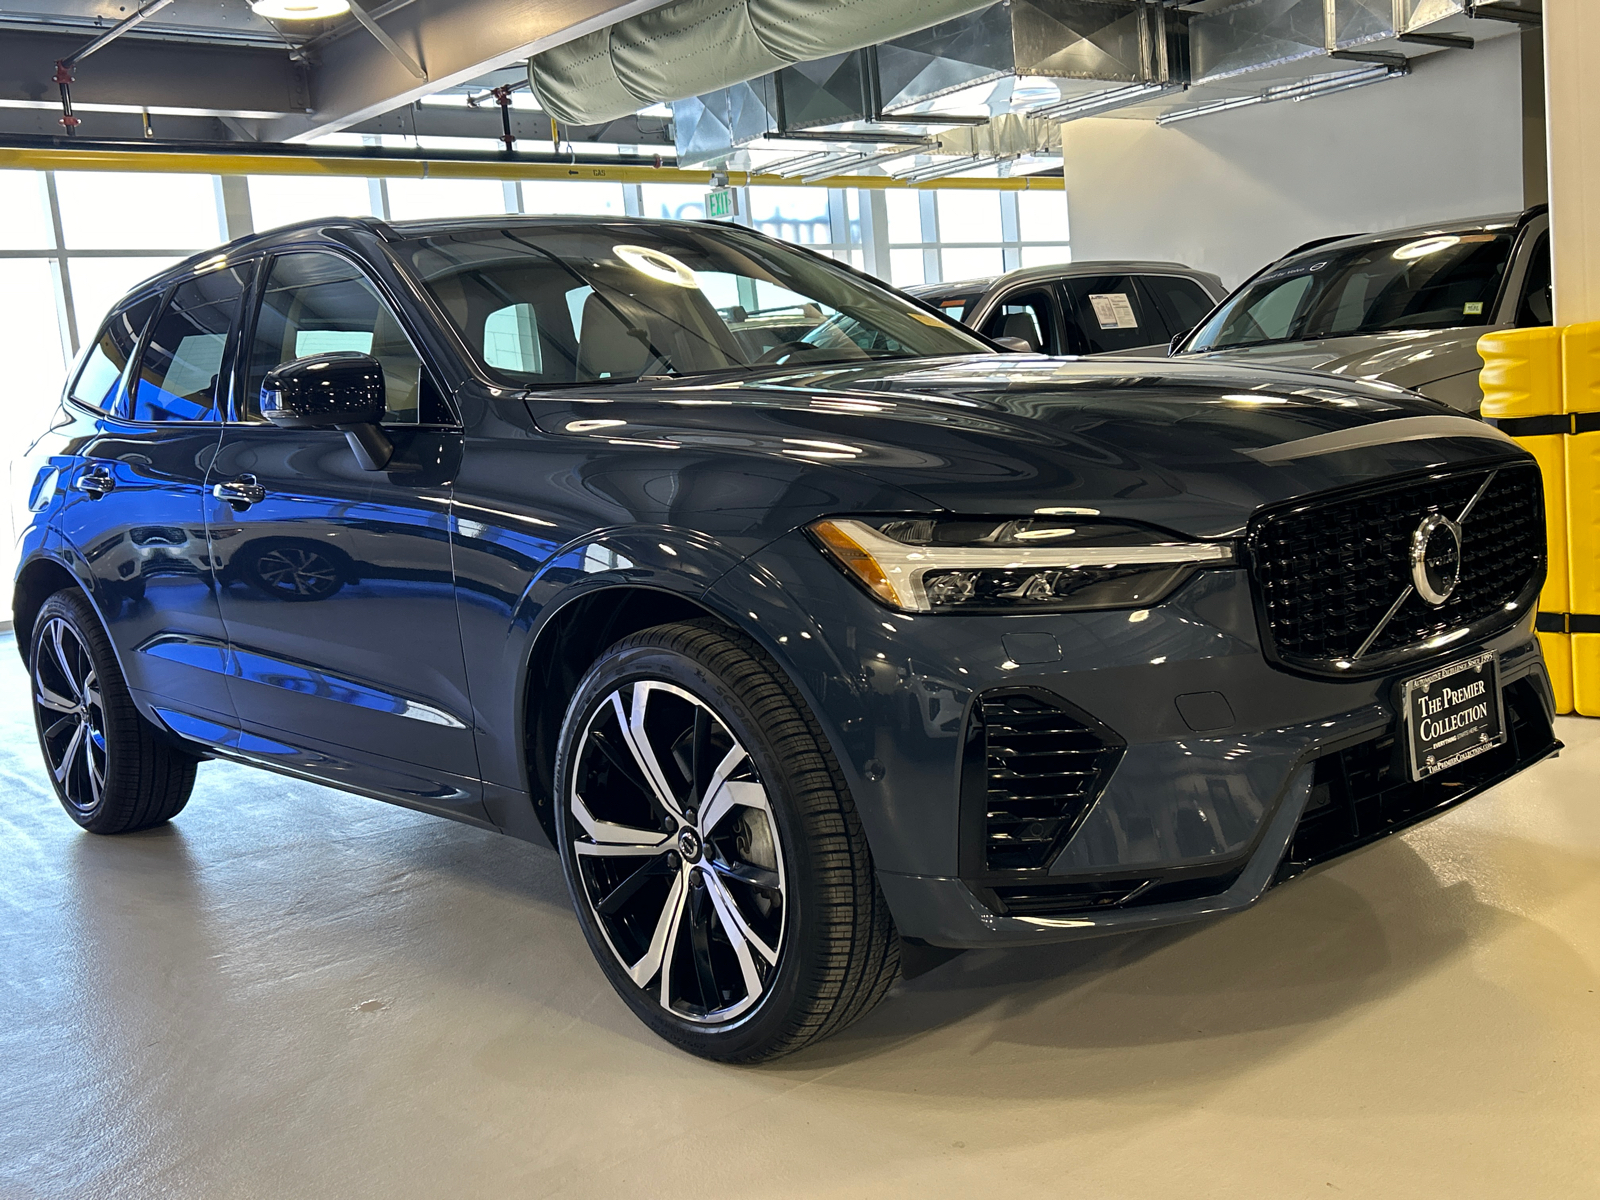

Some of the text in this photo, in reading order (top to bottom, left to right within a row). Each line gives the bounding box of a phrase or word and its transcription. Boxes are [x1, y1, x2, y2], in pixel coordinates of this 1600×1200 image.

[593, 169, 606, 177] GAS
[709, 192, 729, 216] EXIT
[1481, 653, 1493, 664] 1995
[1418, 680, 1485, 718] THE PREMIER
[1420, 702, 1487, 741] COLLECTION
